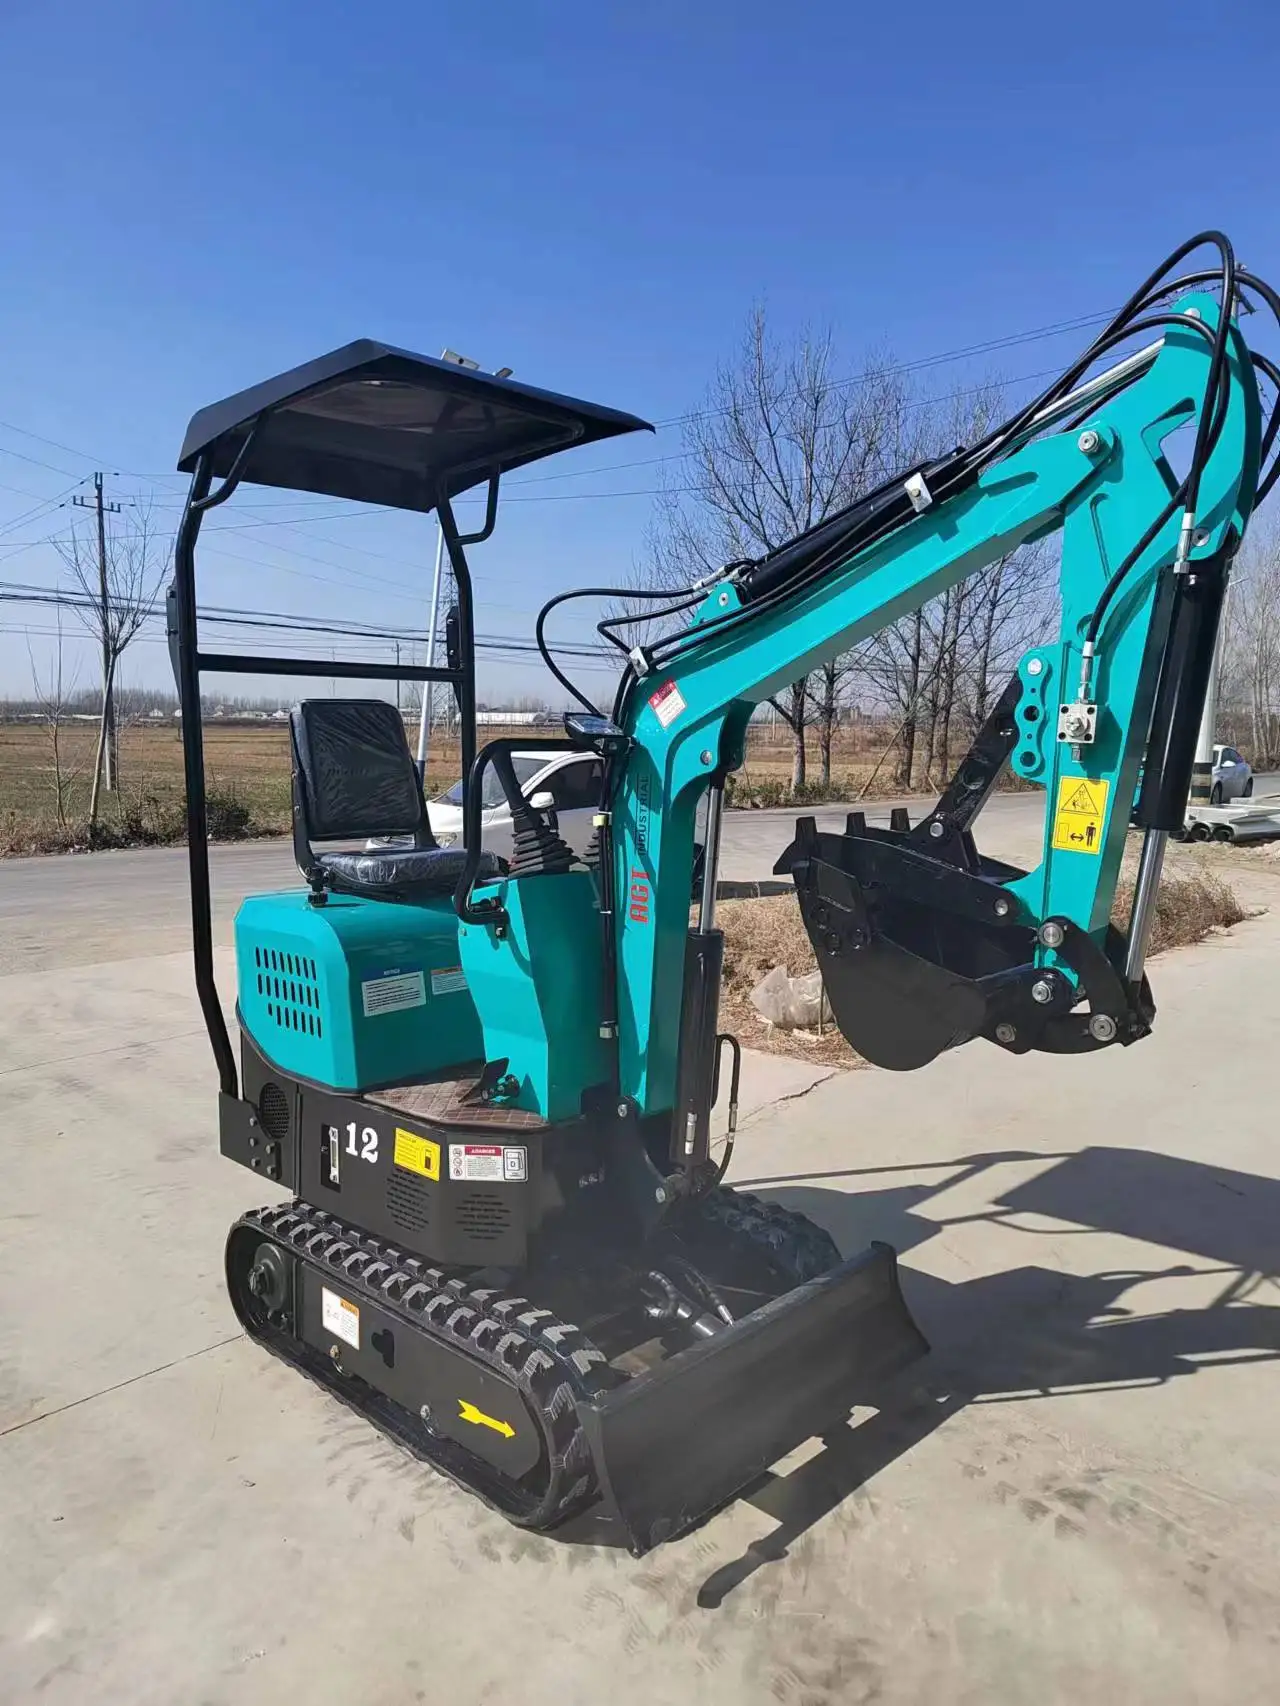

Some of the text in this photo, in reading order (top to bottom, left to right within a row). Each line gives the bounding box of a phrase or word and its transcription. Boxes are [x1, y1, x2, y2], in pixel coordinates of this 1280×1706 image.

[637, 776, 649, 856] INDUSTRIAL
[630, 866, 649, 923] AGT
[345, 1122, 378, 1164] 12
